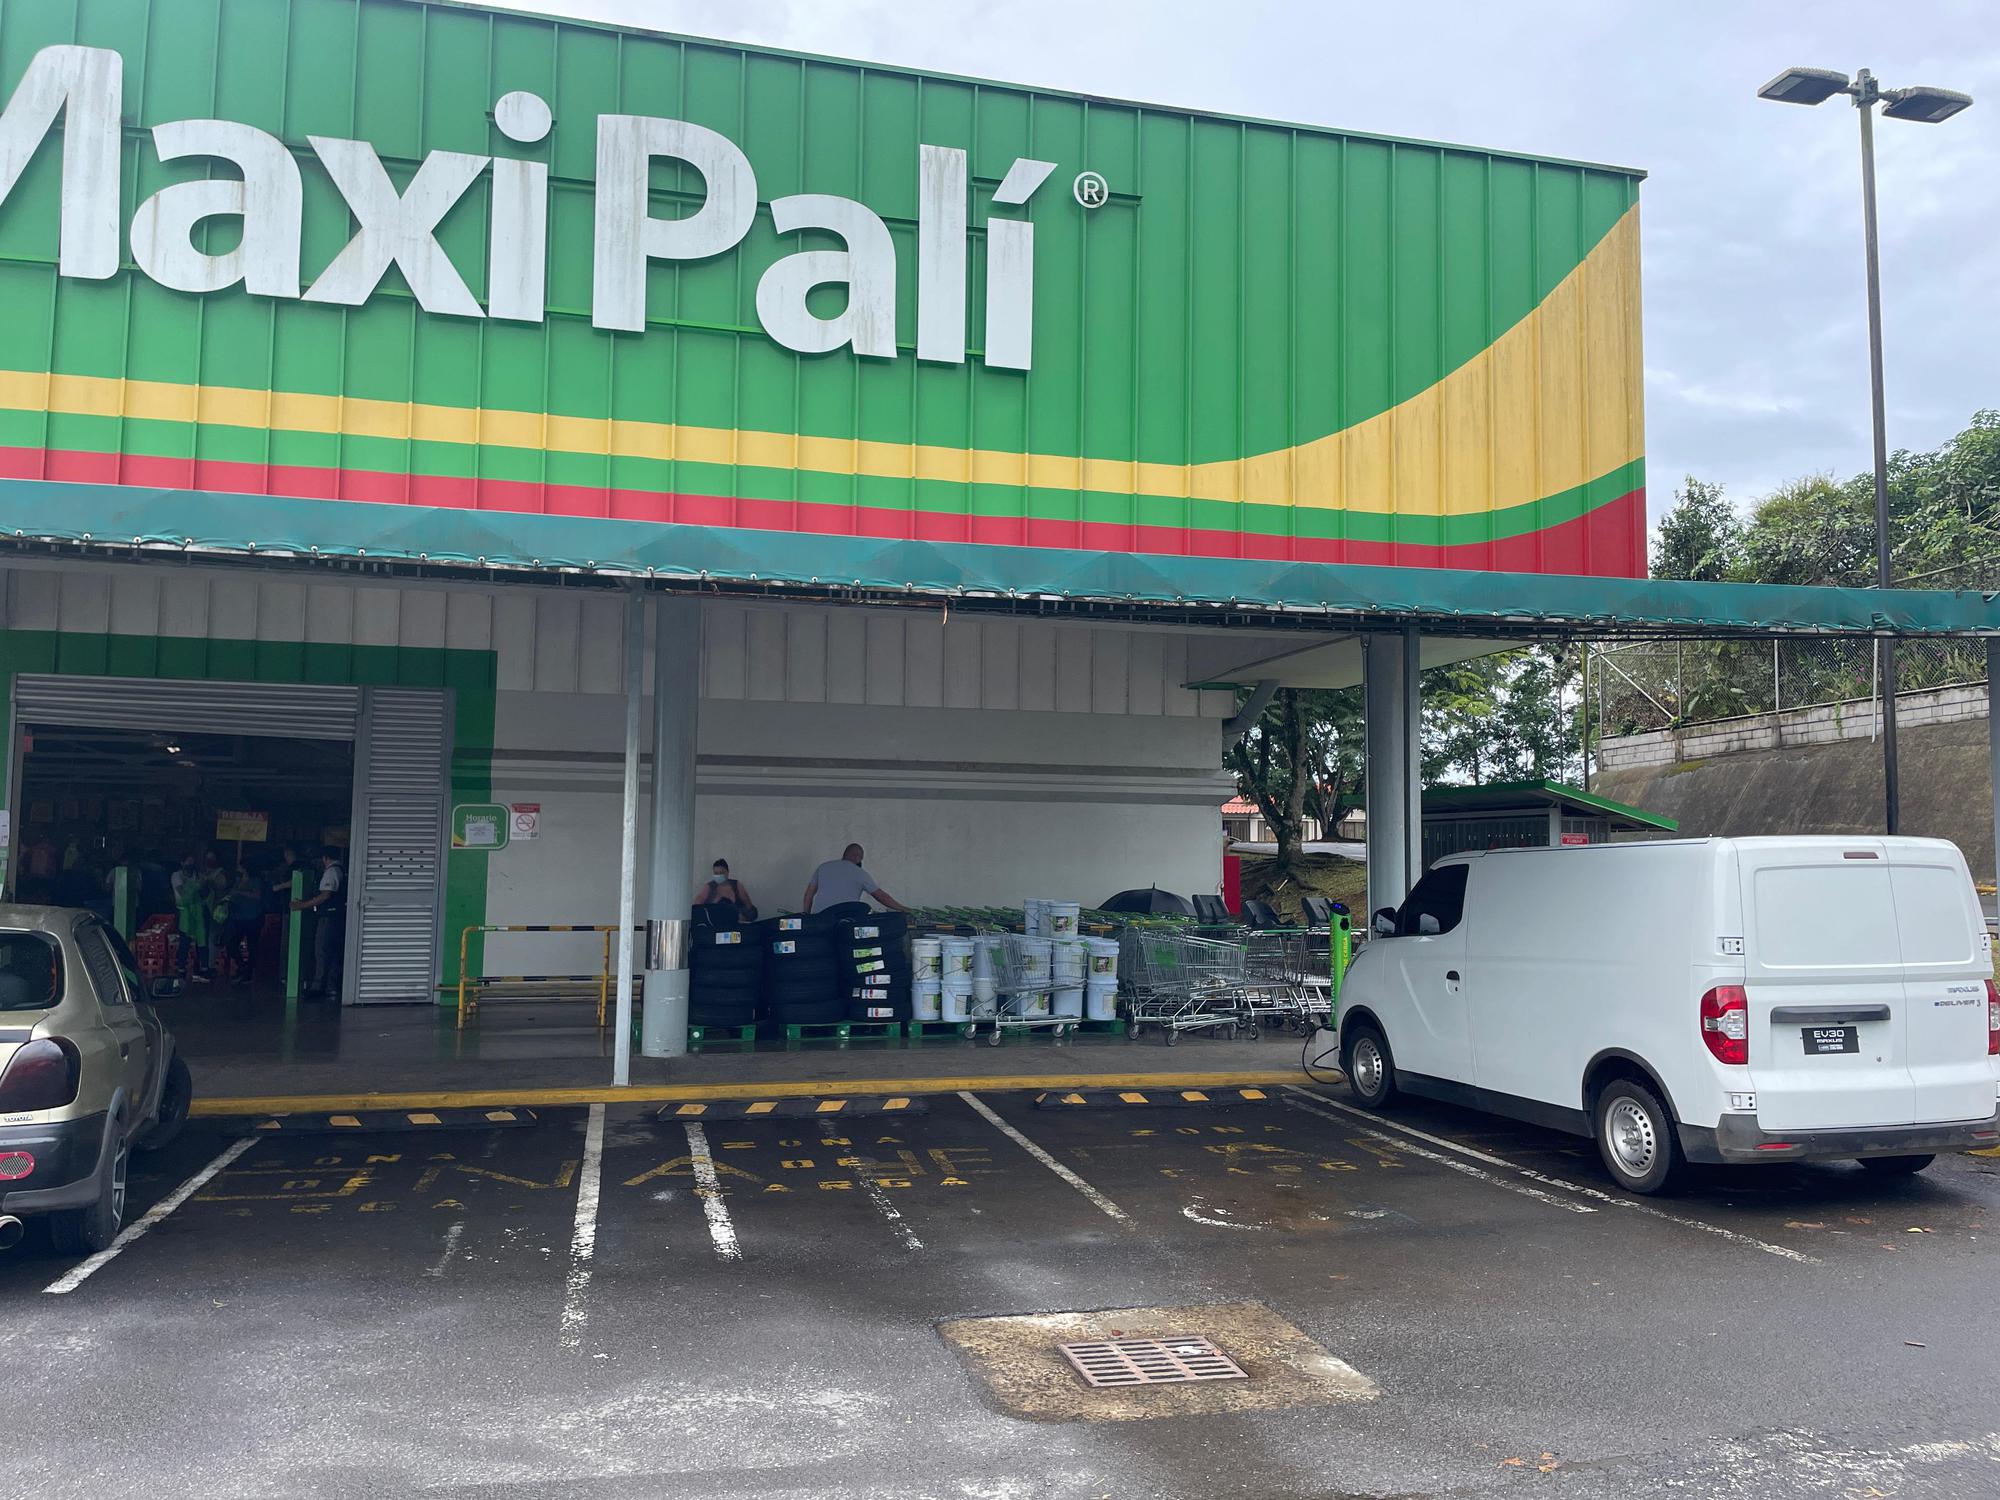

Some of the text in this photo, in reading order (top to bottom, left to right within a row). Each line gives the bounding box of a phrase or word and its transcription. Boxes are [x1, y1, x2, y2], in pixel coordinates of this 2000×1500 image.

[466, 814, 498, 822] Horario
[1813, 1029, 1845, 1038] EV30
[4, 1114, 33, 1122] TOYOTA
[721, 1136, 904, 1149] ZONA
